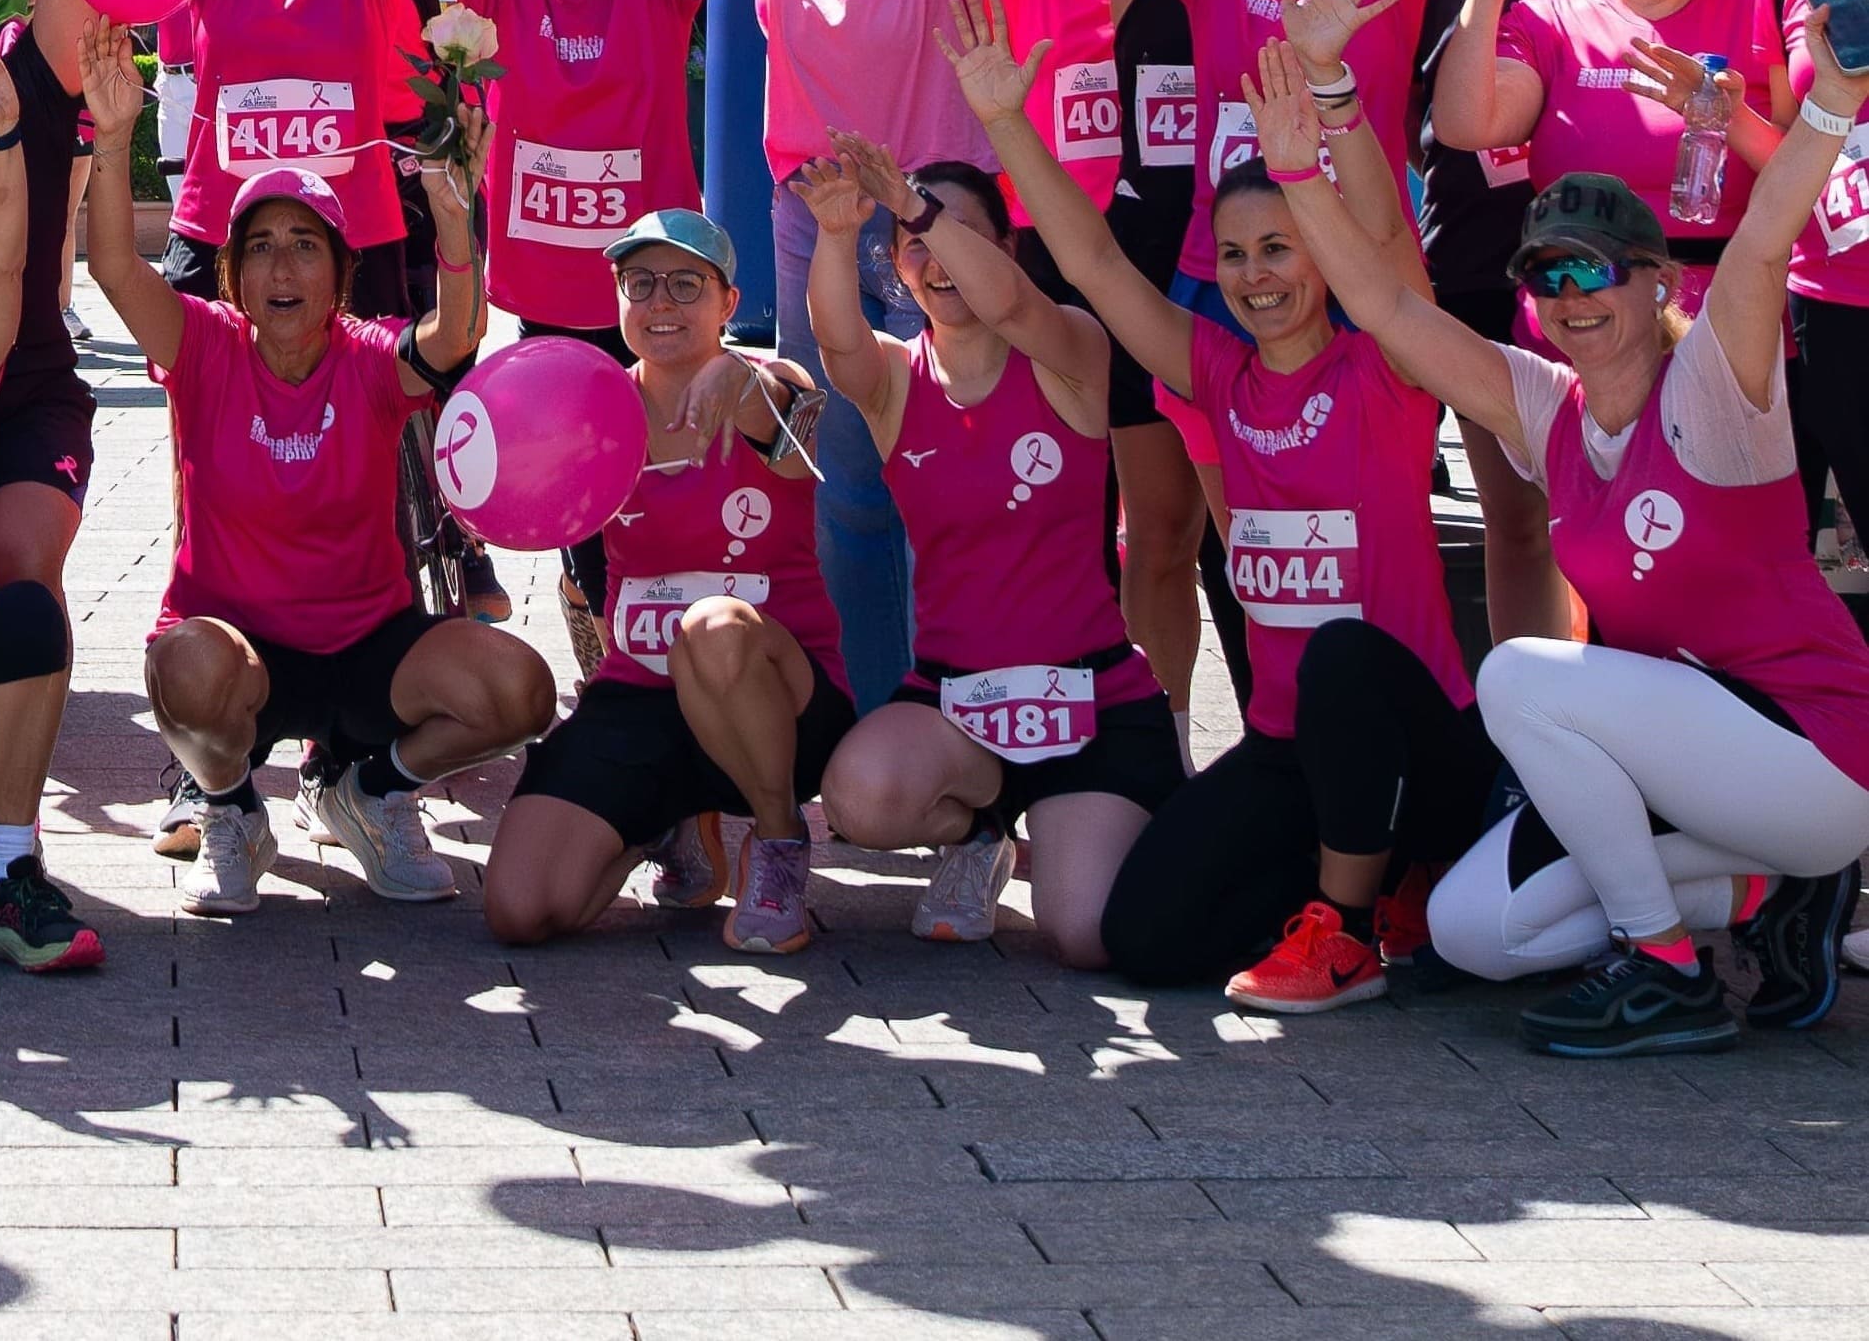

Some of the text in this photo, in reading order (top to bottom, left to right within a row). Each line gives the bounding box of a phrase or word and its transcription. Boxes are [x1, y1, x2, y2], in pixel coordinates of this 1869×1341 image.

[231, 116, 341, 155] 4146
[525, 181, 627, 225] 4133
[1235, 554, 1344, 599] 4044
[957, 705, 1072, 744] 4181
